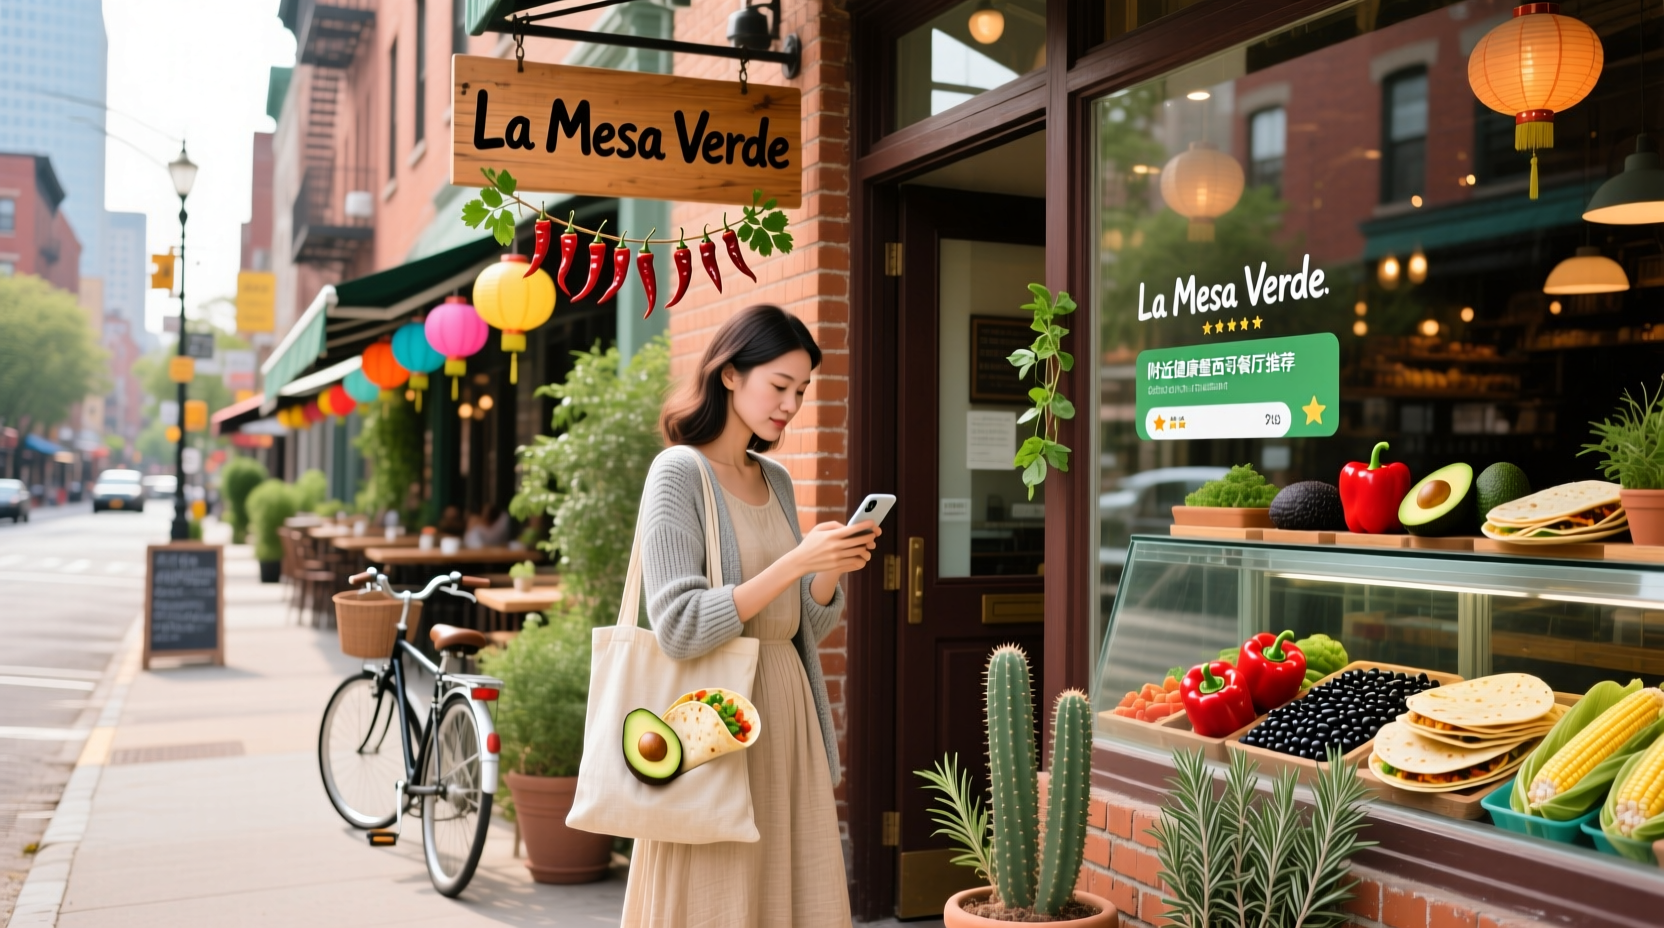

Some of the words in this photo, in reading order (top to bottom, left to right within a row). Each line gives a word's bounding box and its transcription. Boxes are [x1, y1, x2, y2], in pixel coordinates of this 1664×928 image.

[473, 89, 535, 150] La
[546, 98, 666, 160] Mesa
[674, 110, 790, 169] Verde
[1138, 282, 1167, 321] La
[1173, 275, 1238, 317] Mesa
[1244, 254, 1330, 306] Verde.
